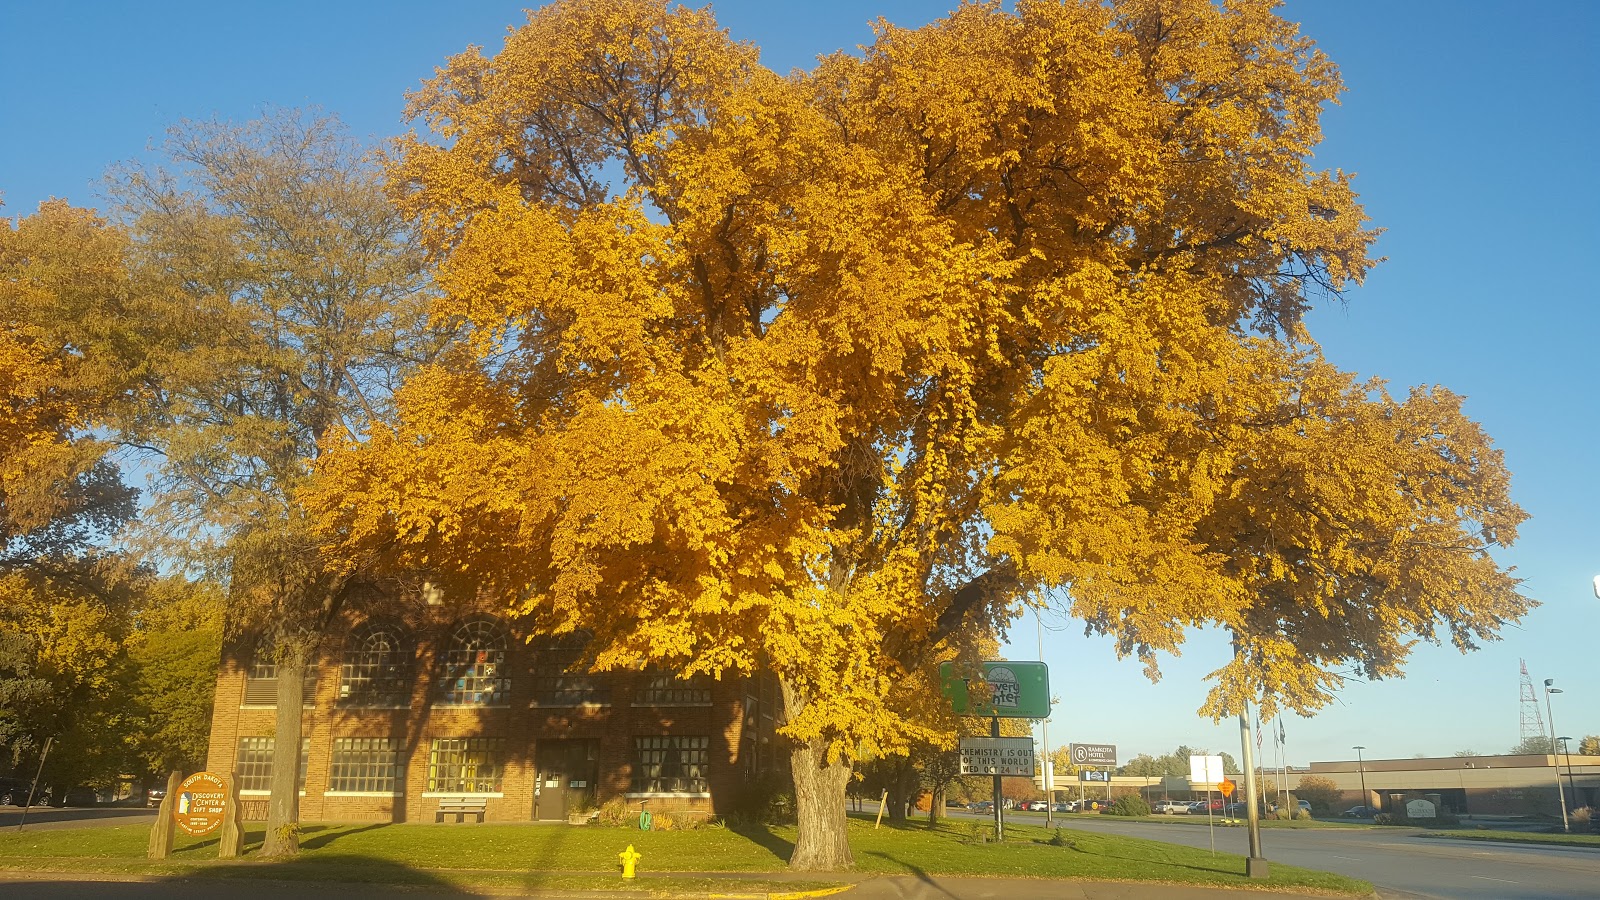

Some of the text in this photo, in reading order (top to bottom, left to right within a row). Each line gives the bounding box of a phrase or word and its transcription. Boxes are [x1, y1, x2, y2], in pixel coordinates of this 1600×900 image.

[960, 748, 1003, 757] CHEMISTRY
[1017, 749, 1033, 757] OUT
[963, 757, 973, 765] OF
[977, 757, 996, 765] THIS
[1001, 766, 1010, 774] 24
[1016, 767, 1029, 775] 1-4
[183, 774, 223, 788] SOUTH DAKOTA
[192, 792, 224, 800] DISCOVERY
